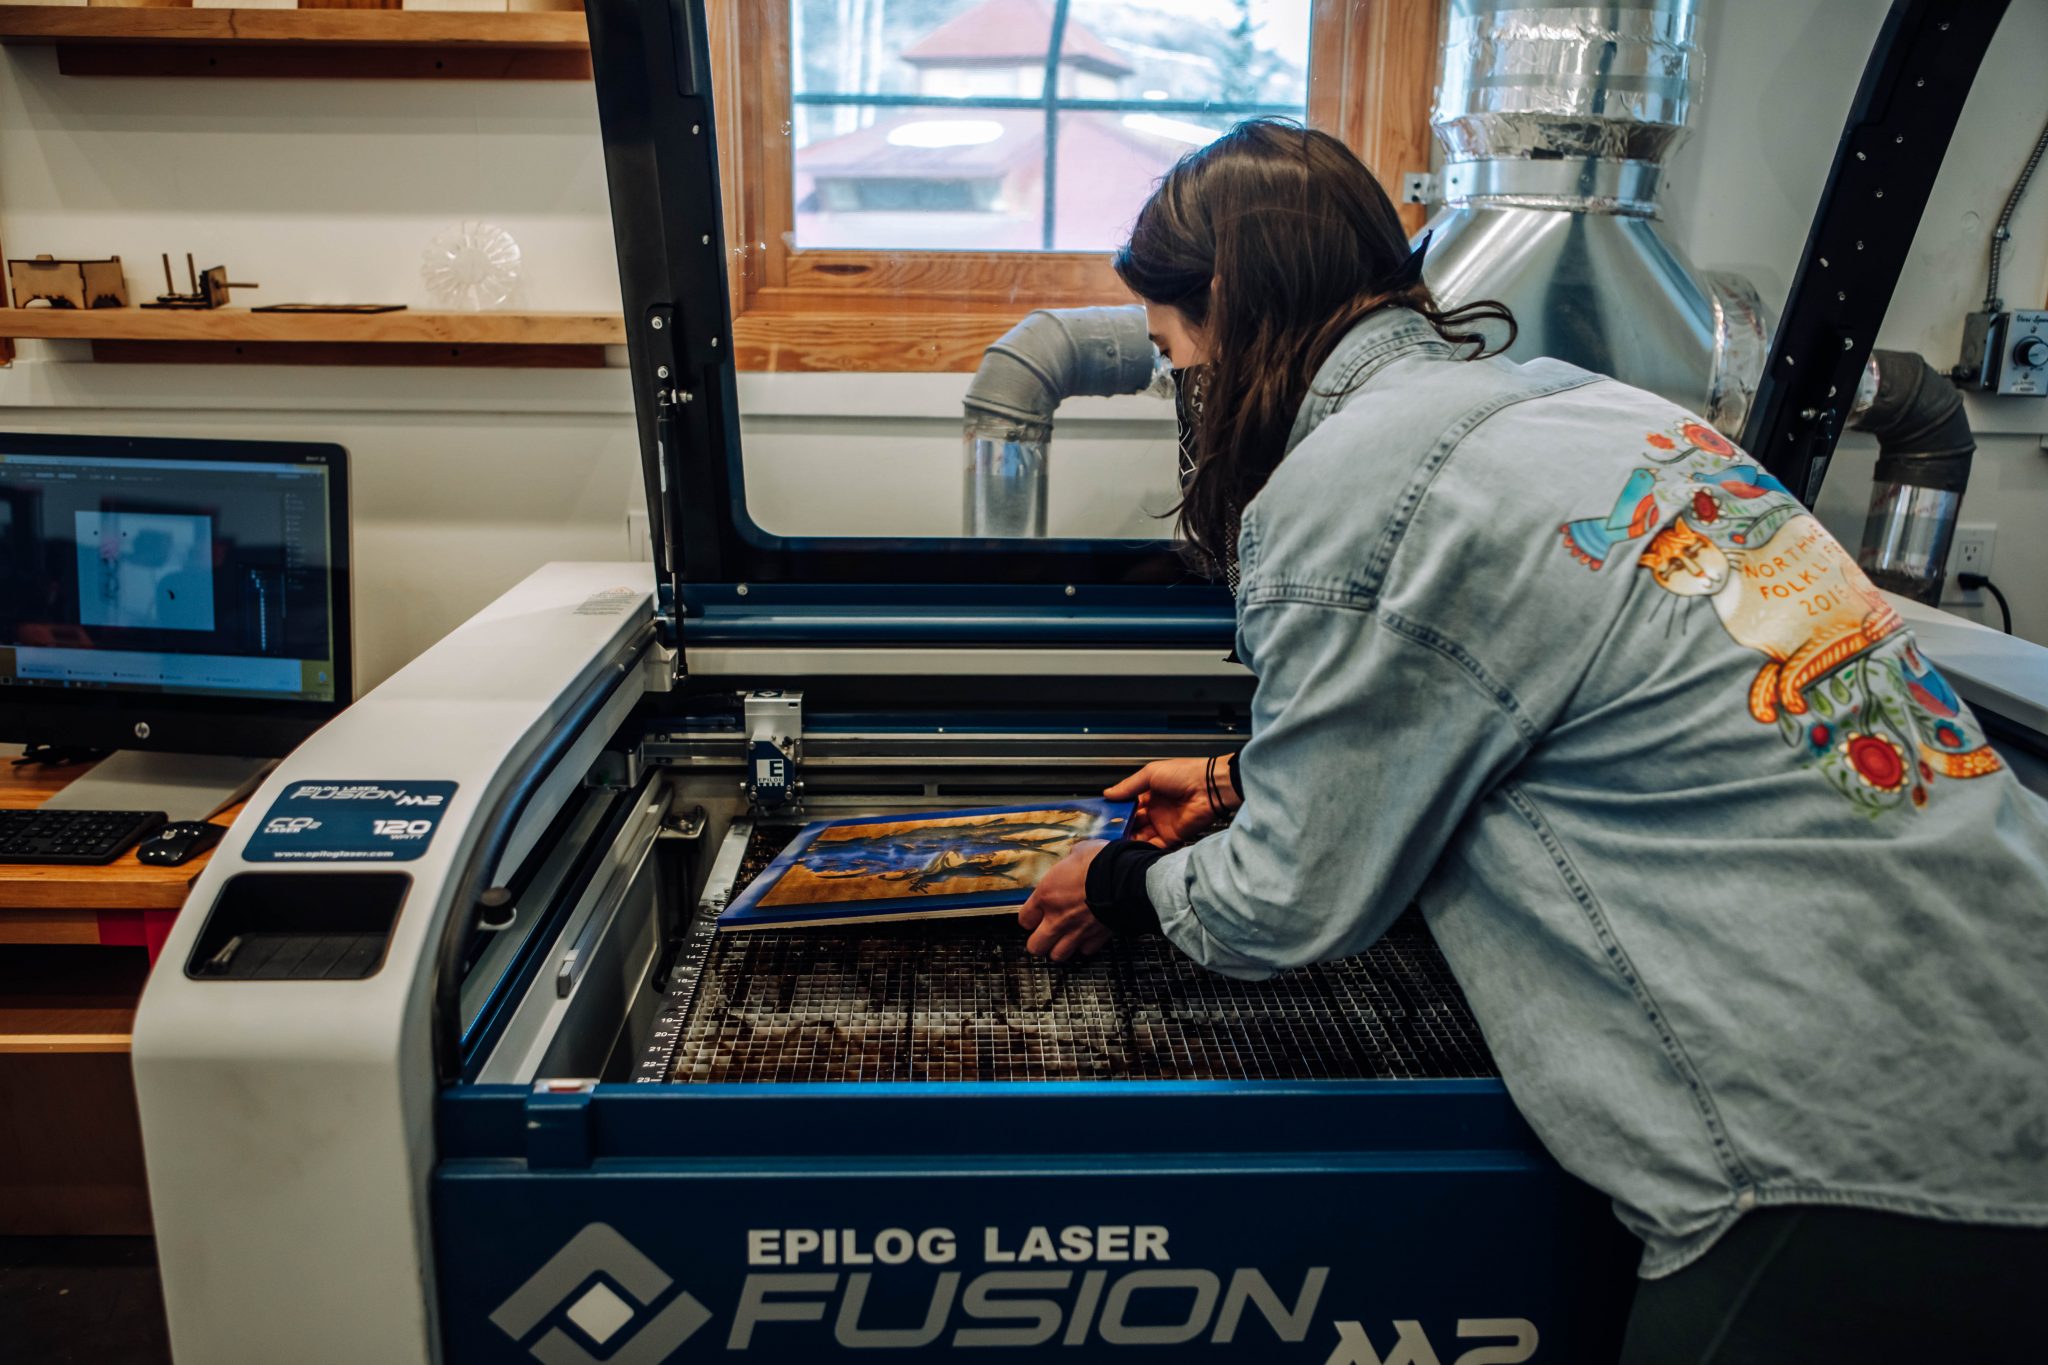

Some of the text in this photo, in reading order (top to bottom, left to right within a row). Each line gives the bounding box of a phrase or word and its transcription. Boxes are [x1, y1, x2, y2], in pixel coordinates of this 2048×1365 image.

[290, 790, 444, 806] FUSION M2
[373, 819, 433, 835] 120
[274, 850, 394, 859] www.epiloglaser.com
[747, 1225, 1171, 1266] EPILOG LASER
[726, 1267, 1331, 1350] FUSION
